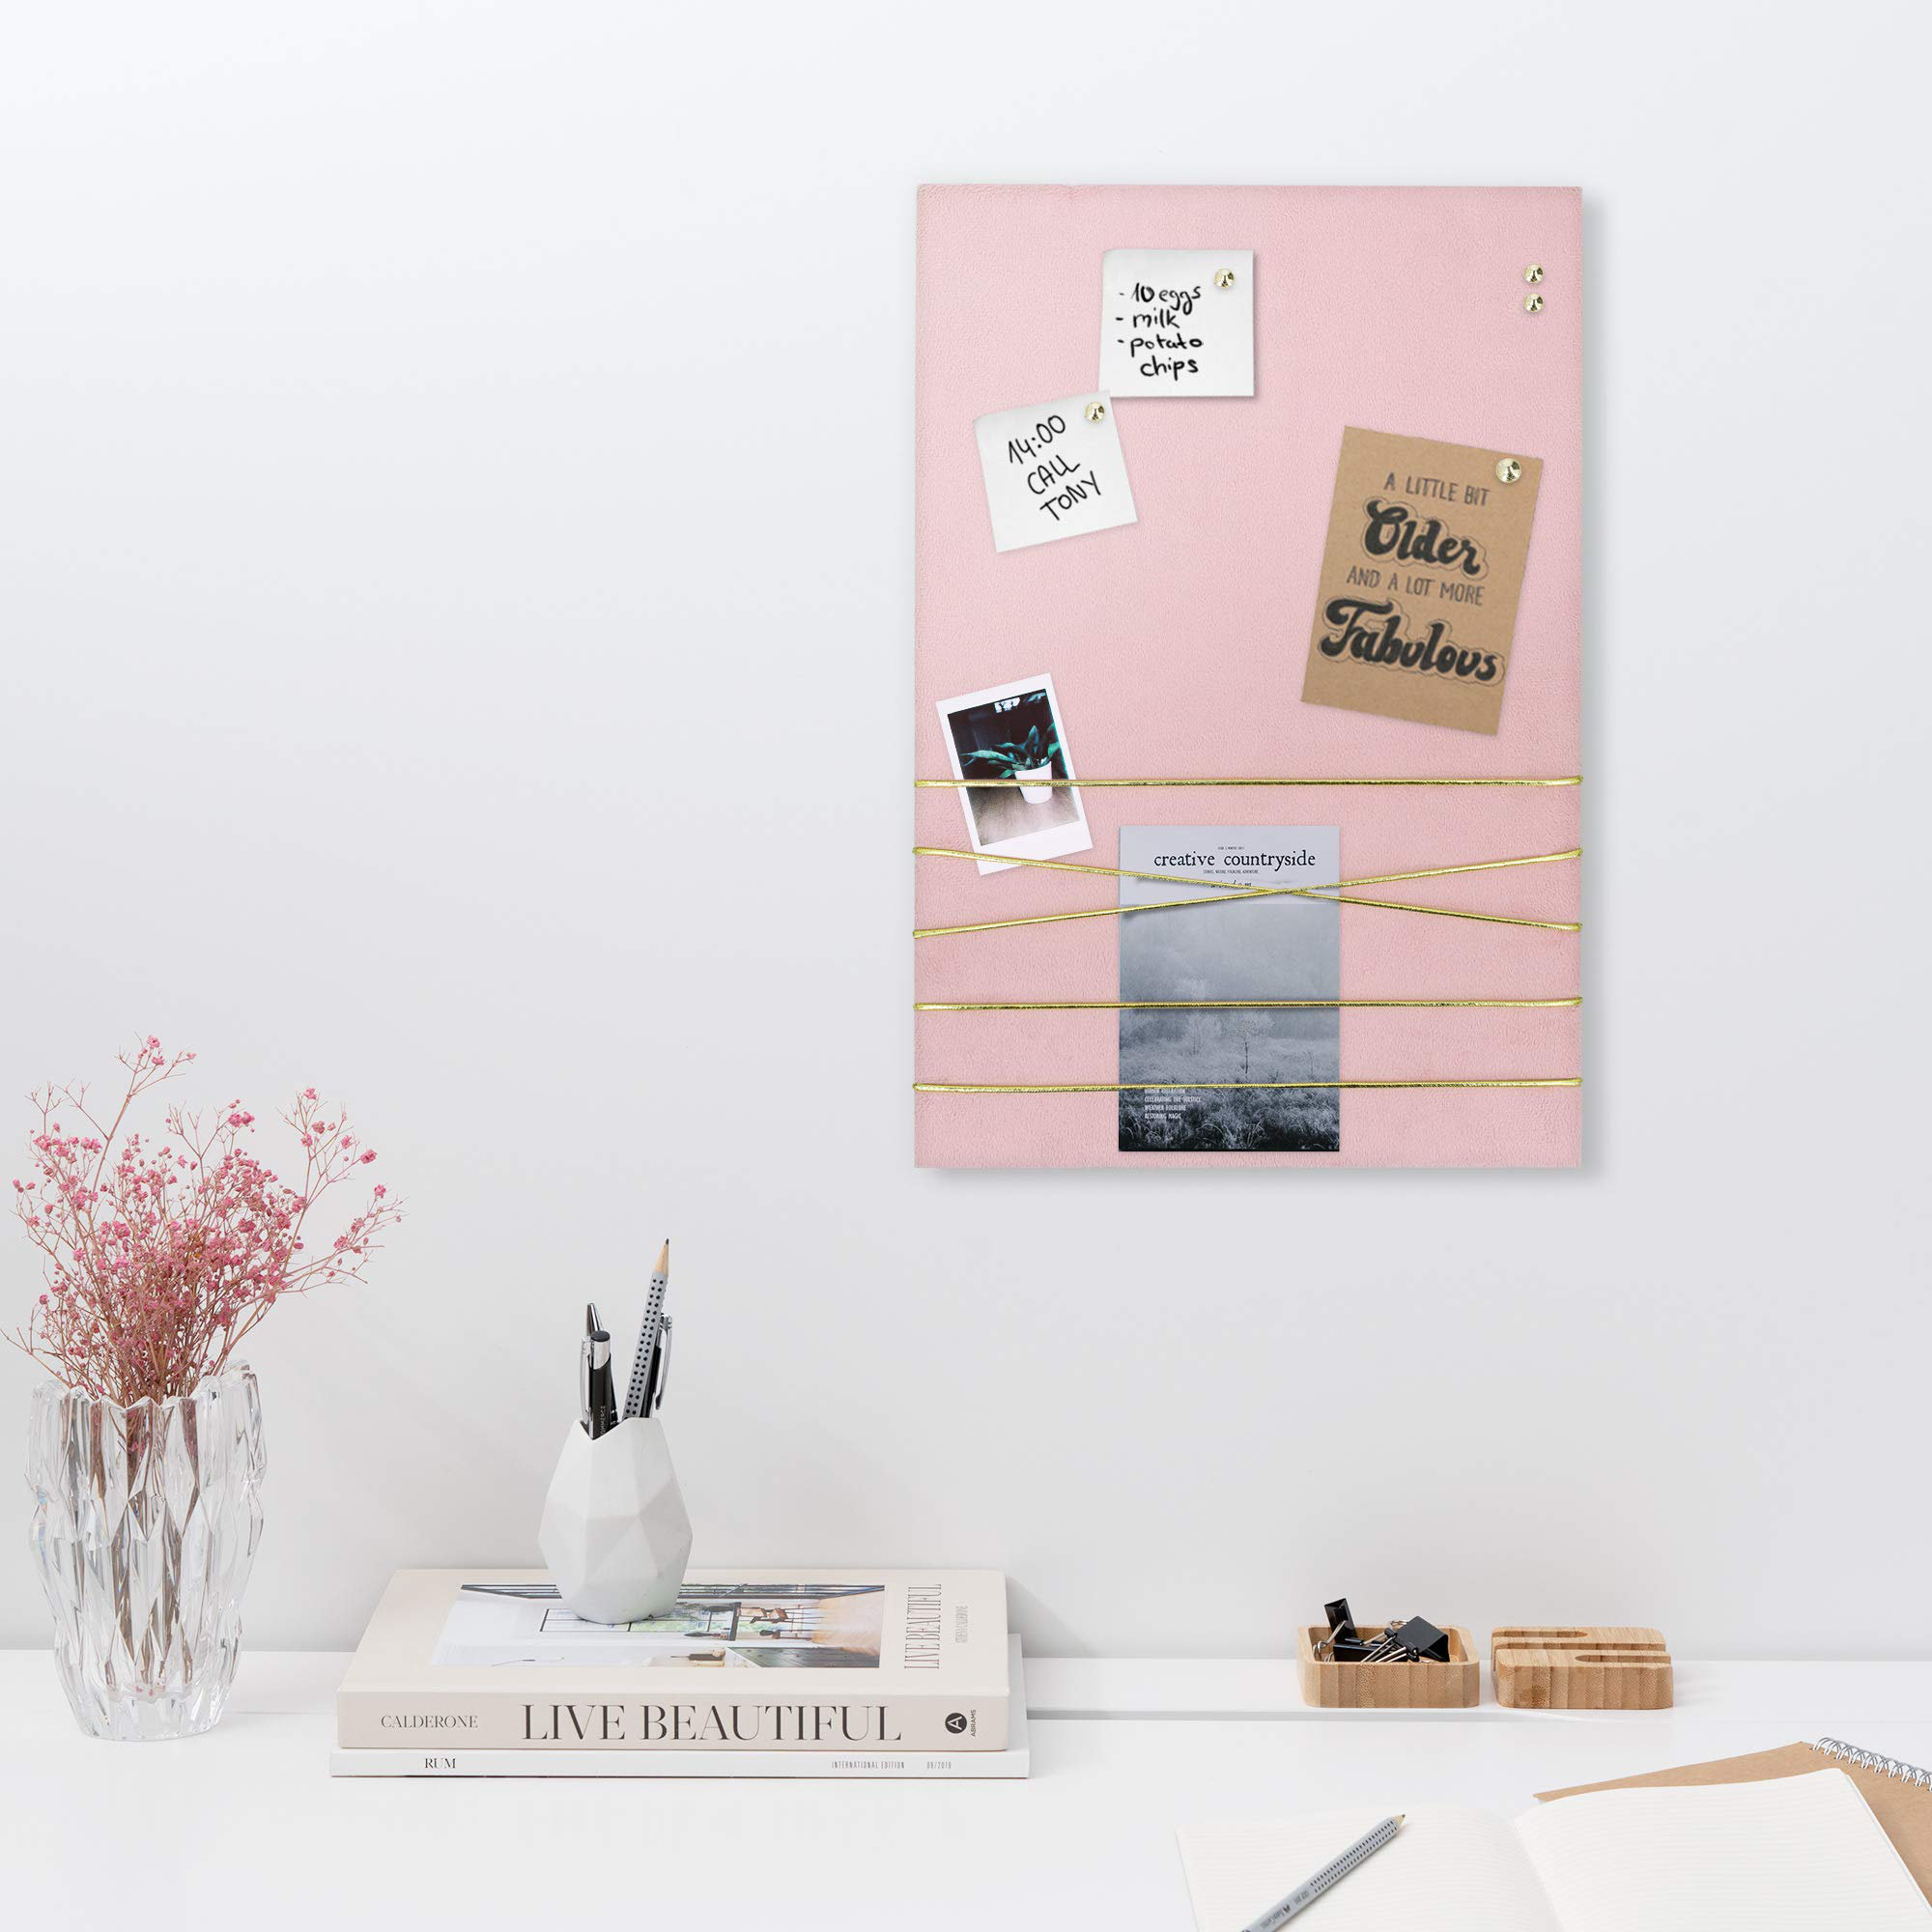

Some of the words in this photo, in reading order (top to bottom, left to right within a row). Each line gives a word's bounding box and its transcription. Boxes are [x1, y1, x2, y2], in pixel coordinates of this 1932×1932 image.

[1131, 282, 1155, 302] 10
[1158, 286, 1202, 315] eggs
[1132, 307, 1180, 328] milk
[1130, 332, 1204, 357] potato
[1140, 355, 1199, 382] chips
[1008, 415, 1066, 465] 14:00
[1027, 454, 1081, 495] CALL
[1383, 471, 1396, 491] A
[1406, 475, 1459, 501] LITTLE
[1464, 485, 1492, 506] BIT
[1039, 470, 1101, 522] TONY
[1364, 499, 1481, 576] Older
[1346, 565, 1381, 588] AND
[1387, 572, 1399, 591] A
[1406, 576, 1436, 596] LOT
[1439, 582, 1486, 607] MORE
[1321, 598, 1499, 682] Fabulous
[1153, 850, 1215, 867] creative
[1223, 850, 1316, 872] countryside
[905, 1583, 942, 1641] BEAUTIFUL
[904, 1642, 940, 1669] LIVE
[381, 1715, 478, 1729] CALDERONE
[522, 1704, 626, 1741] LIVE
[639, 1704, 902, 1742] BEAUTIFUL
[424, 1757, 456, 1769] RUM
[831, 1761, 878, 1770] INTERNATIONAL
[880, 1761, 905, 1770] EDITION
